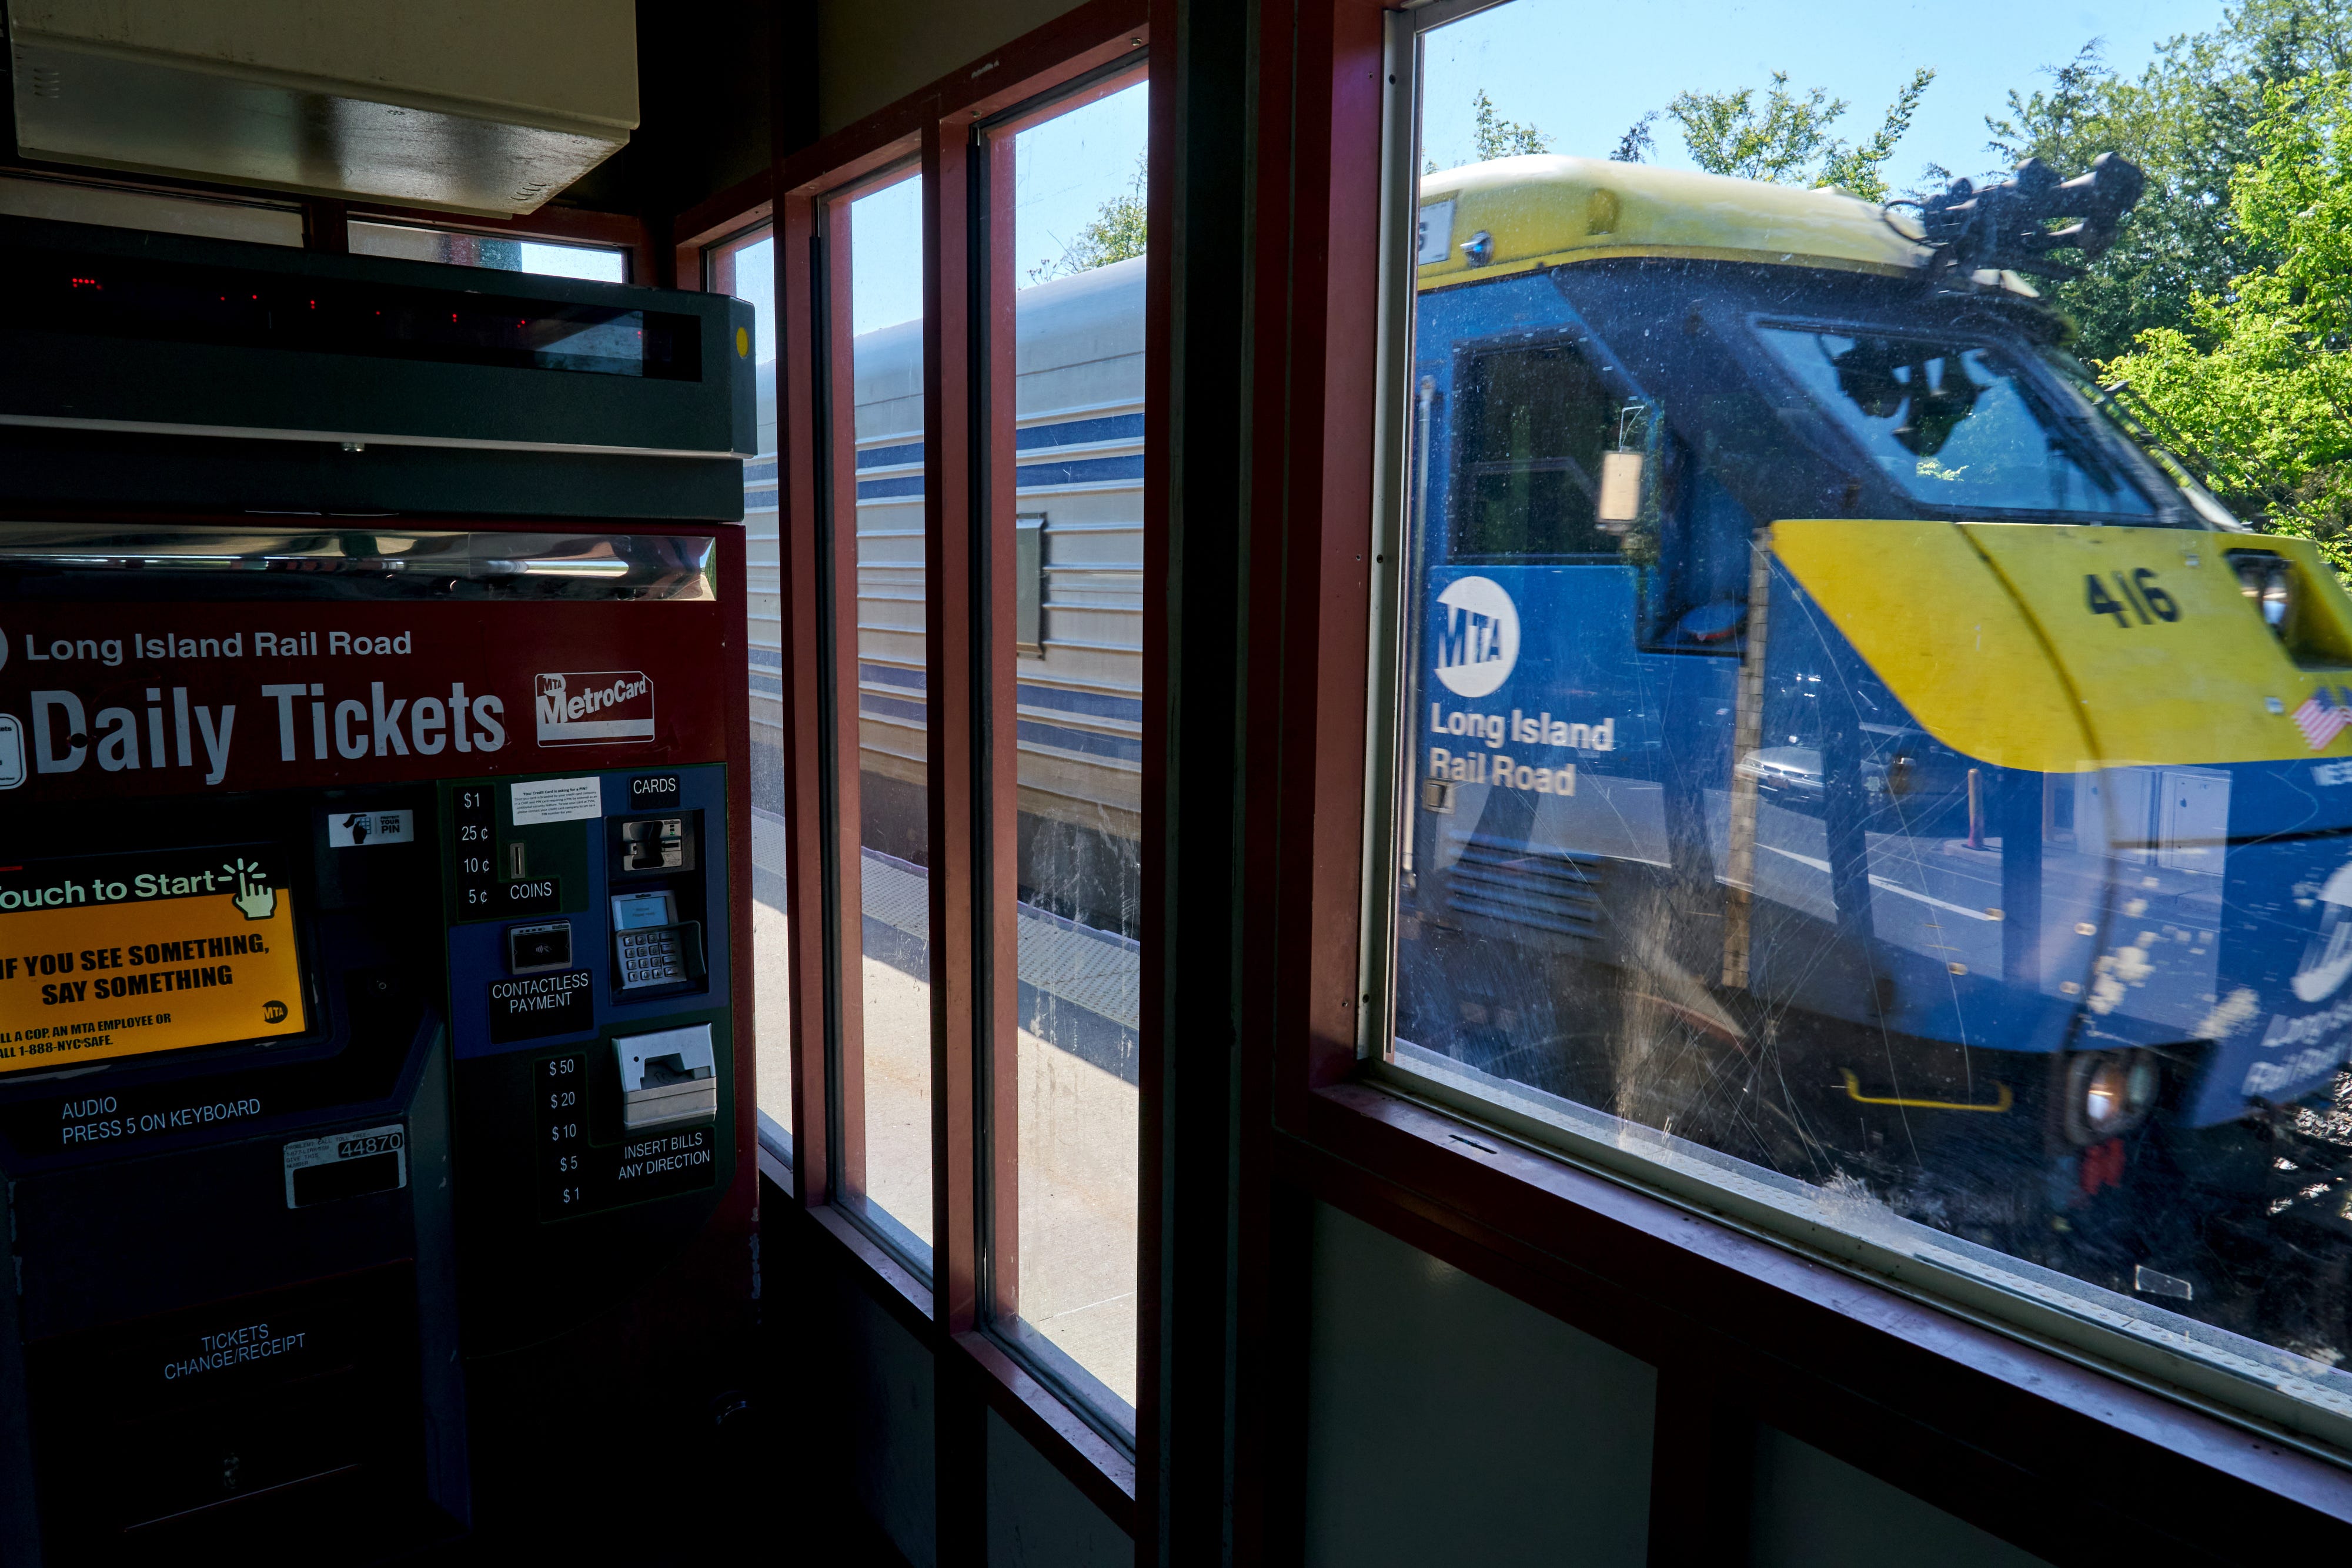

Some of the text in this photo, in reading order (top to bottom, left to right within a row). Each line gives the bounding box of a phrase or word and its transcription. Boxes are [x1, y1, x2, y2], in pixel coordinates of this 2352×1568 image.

[2083, 567, 2181, 628] 416
[26, 630, 411, 666] Long Island Rail Road
[1435, 593, 1510, 681] MTA
[537, 676, 646, 724] MetroCard
[543, 677, 563, 693] MTA
[31, 681, 505, 785] Daily Tickets
[1431, 703, 1615, 751] Long Island
[633, 778, 676, 794] CARDS
[1429, 747, 1576, 797] Rail Road
[382, 825, 400, 834] PIN
[0, 870, 216, 909] ouch to Start
[510, 882, 552, 900] COINS
[24, 952, 75, 977] YOU
[81, 947, 123, 971] SEE
[129, 933, 269, 966] SOMETHING,
[42, 964, 233, 1005] SAY SOMETHING
[492, 972, 589, 999] CONTACTLESS
[262, 1003, 286, 1022] MTA
[510, 992, 572, 1014] PAYMENT
[15, 1031, 22, 1042] A
[52, 1025, 68, 1037] AN
[71, 1022, 96, 1035] MTA
[98, 1015, 153, 1032] EMPLOYEE
[156, 1013, 171, 1024] OR
[63, 1096, 117, 1119] AUDIO
[63, 1098, 260, 1144] PRESS 5 ON KEYBOARD
[341, 1134, 401, 1156] 44870
[624, 1132, 703, 1159] INSERT BILLS
[619, 1149, 710, 1180] ANY DIRECTION
[201, 1323, 269, 1352] TICKETS
[164, 1332, 306, 1380] CHANGE/RECEIPT
